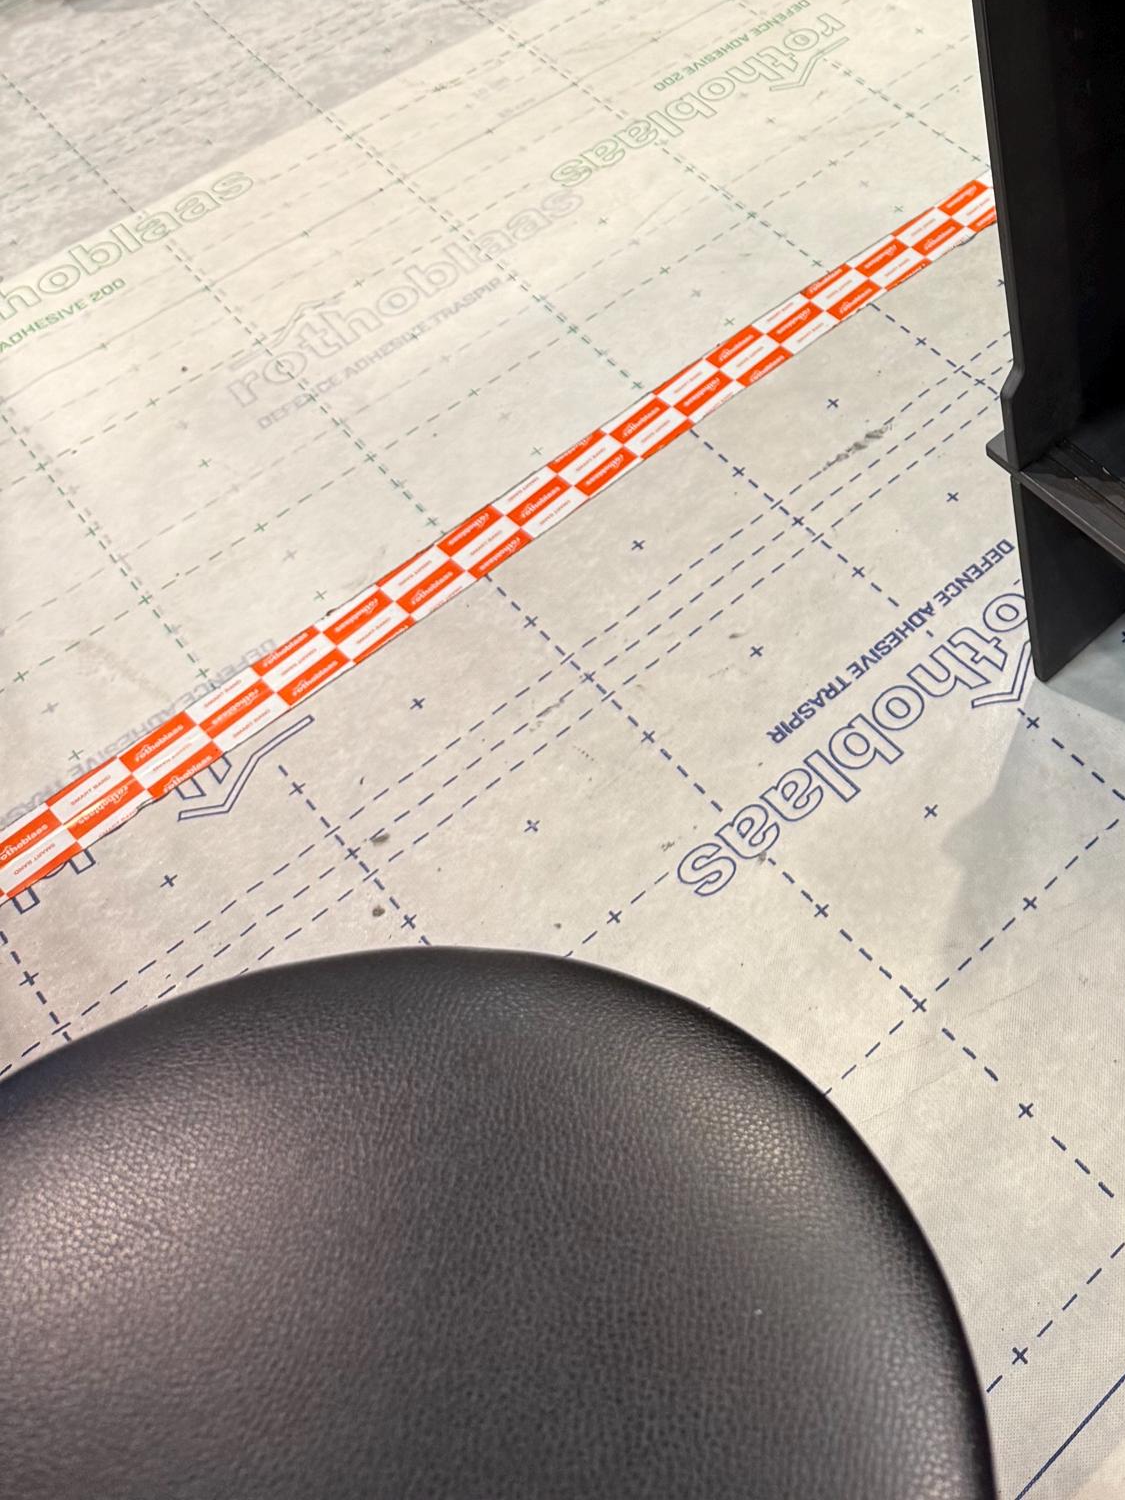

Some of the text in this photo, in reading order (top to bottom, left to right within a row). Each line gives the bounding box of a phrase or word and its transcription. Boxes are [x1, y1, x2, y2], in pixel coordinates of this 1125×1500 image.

[653, 0, 811, 92] DEFENCE ADHESIVE 200
[551, 12, 846, 187] rothoblaas
[89, 277, 127, 303] 200
[226, 189, 584, 408] rothoblaas
[262, 632, 308, 668] rothoblaas
[766, 538, 1015, 744] DEFENCE ADHESIVE TRASPIR
[292, 660, 339, 696] rothoblaas
[135, 724, 184, 762] rothoblaas
[677, 592, 1028, 897] othoblaas
[77, 785, 129, 826] rothoblaas
